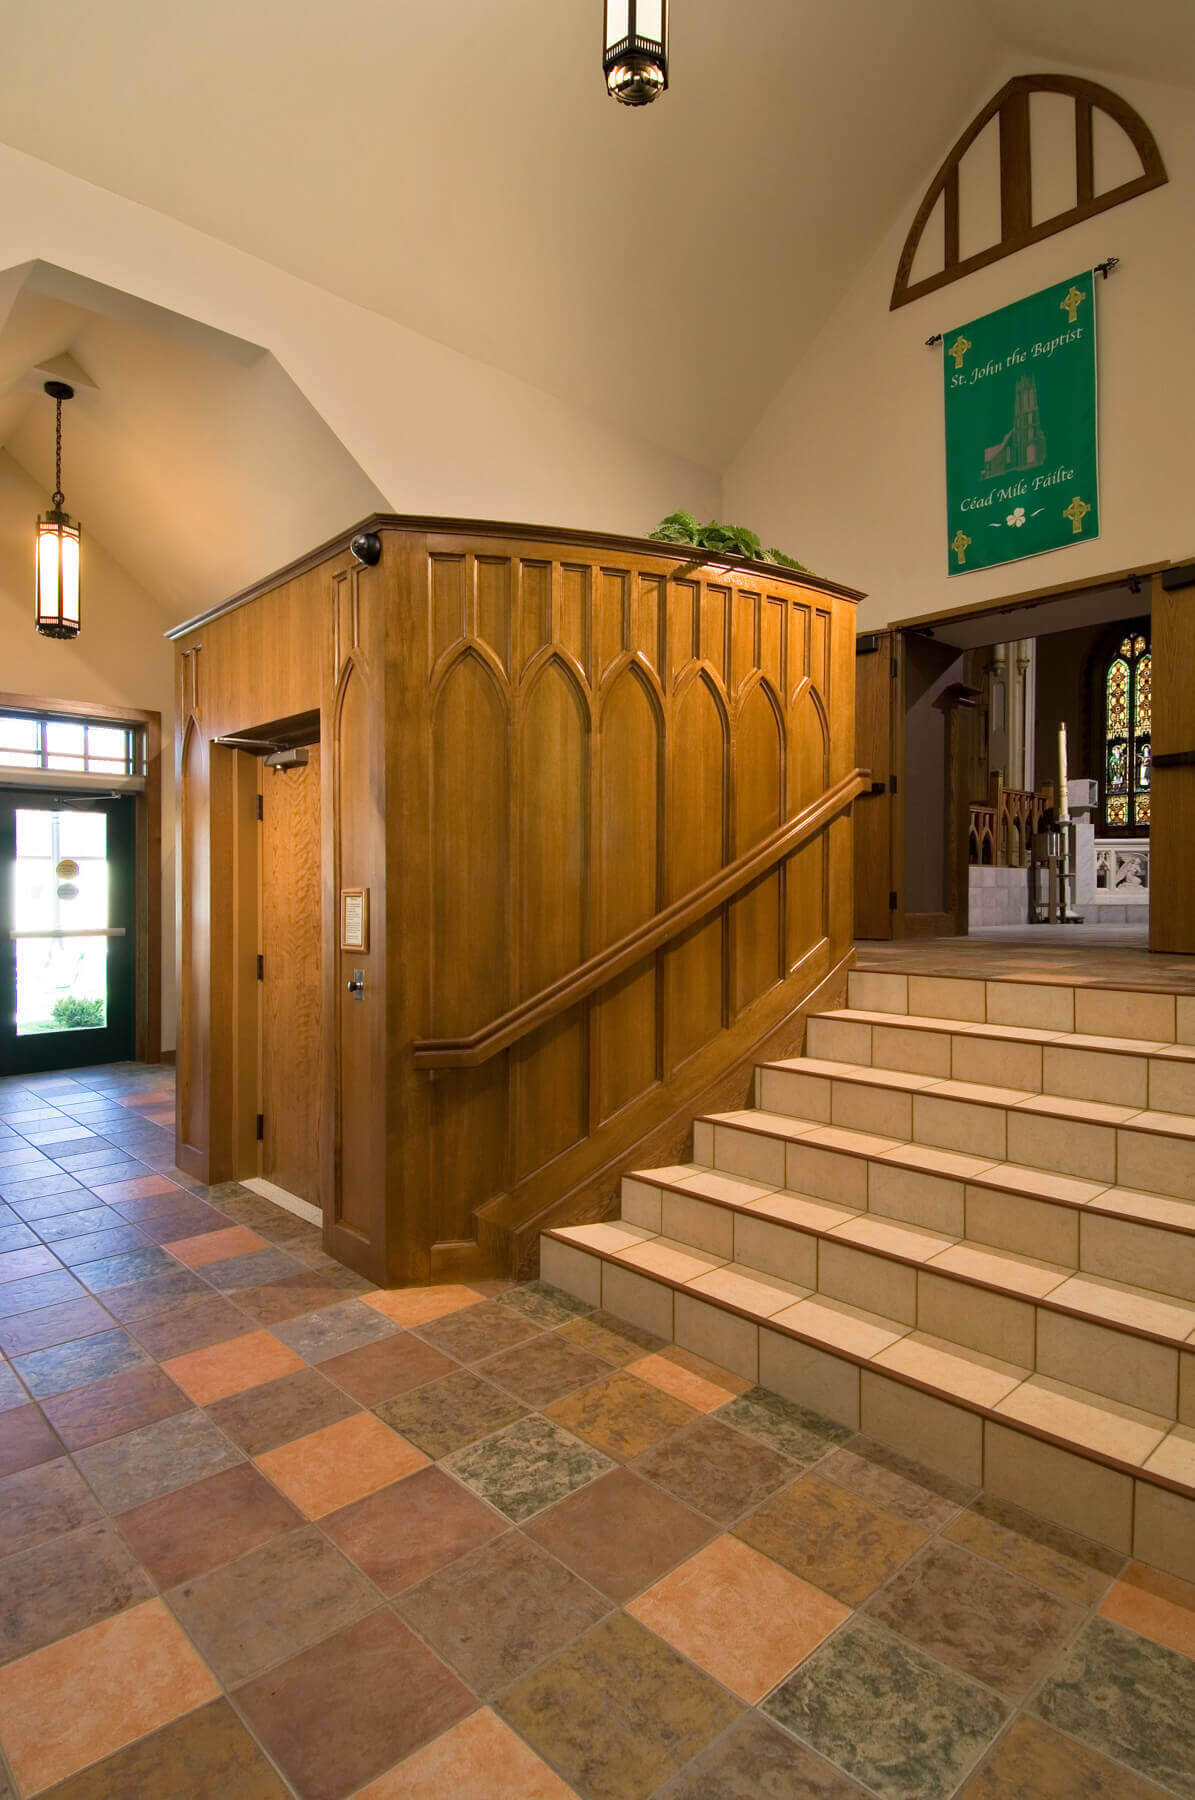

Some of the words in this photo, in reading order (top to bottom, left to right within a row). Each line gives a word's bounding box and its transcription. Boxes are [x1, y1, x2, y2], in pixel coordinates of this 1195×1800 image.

[951, 374, 967, 388] St.
[970, 360, 1002, 384] John
[1006, 348, 1027, 368] the
[1031, 327, 1083, 358] Baptist
[960, 488, 995, 512] Céad
[1032, 465, 1074, 491] Fáilte
